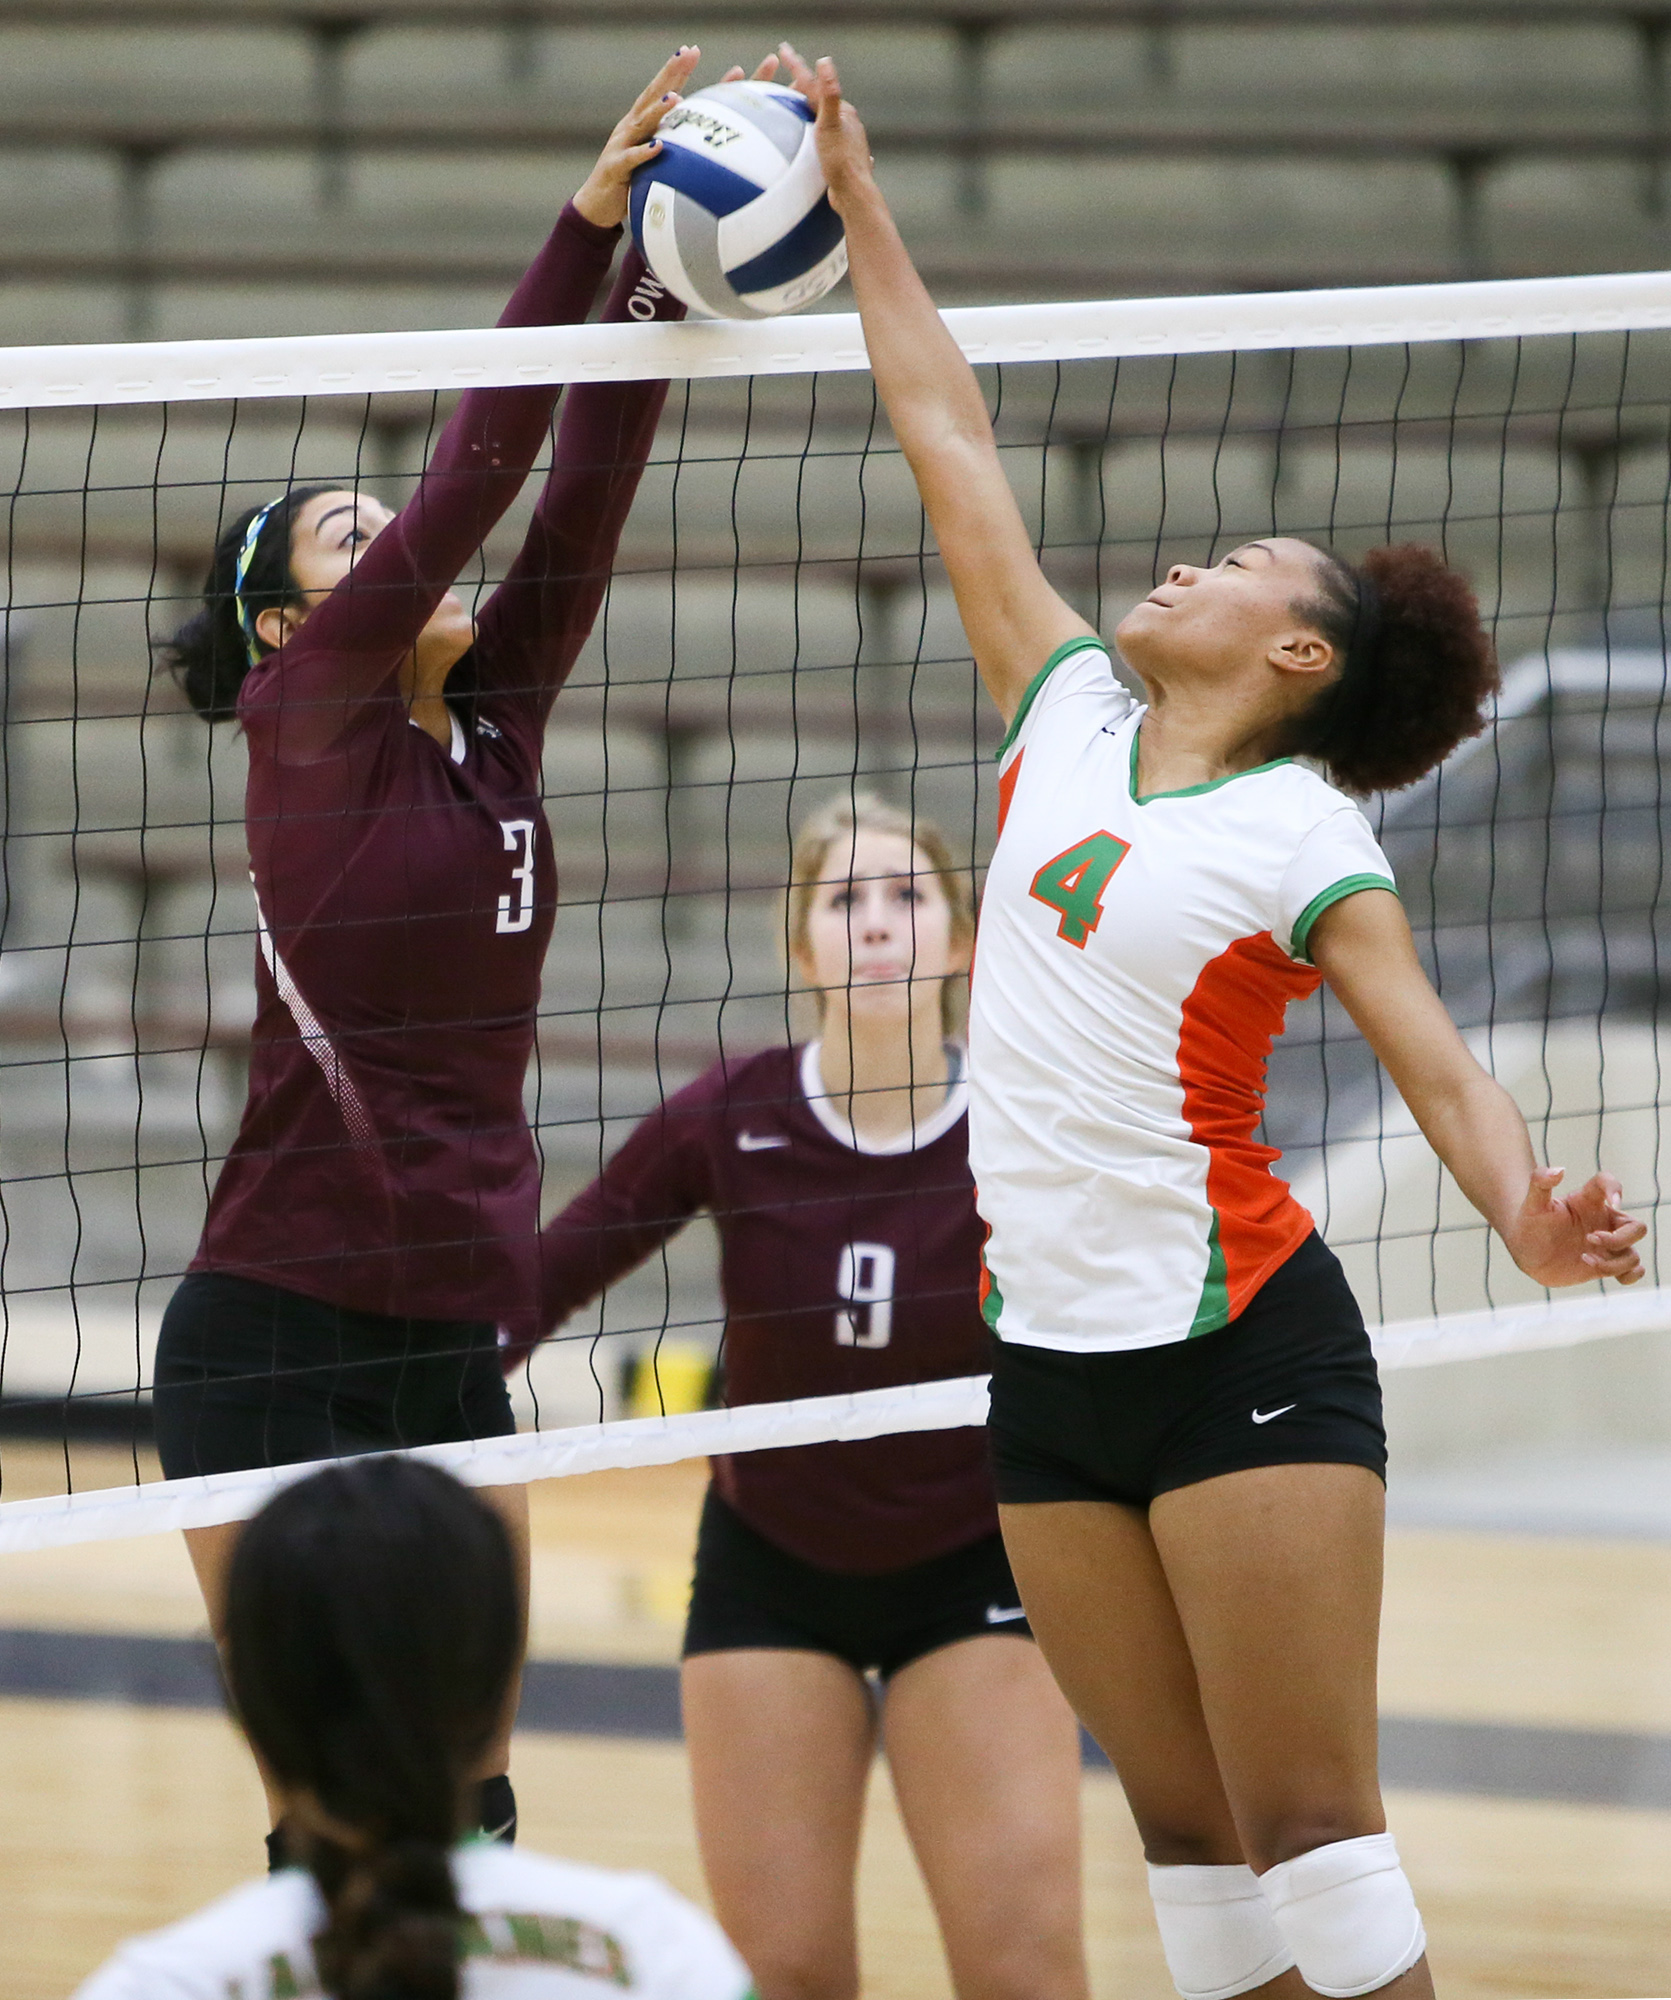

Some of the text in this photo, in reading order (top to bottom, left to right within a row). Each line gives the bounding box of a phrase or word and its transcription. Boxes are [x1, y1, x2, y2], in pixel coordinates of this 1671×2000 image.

[496, 819, 536, 934] 3
[1028, 829, 1132, 950] 4
[835, 1241, 896, 1349] 9
